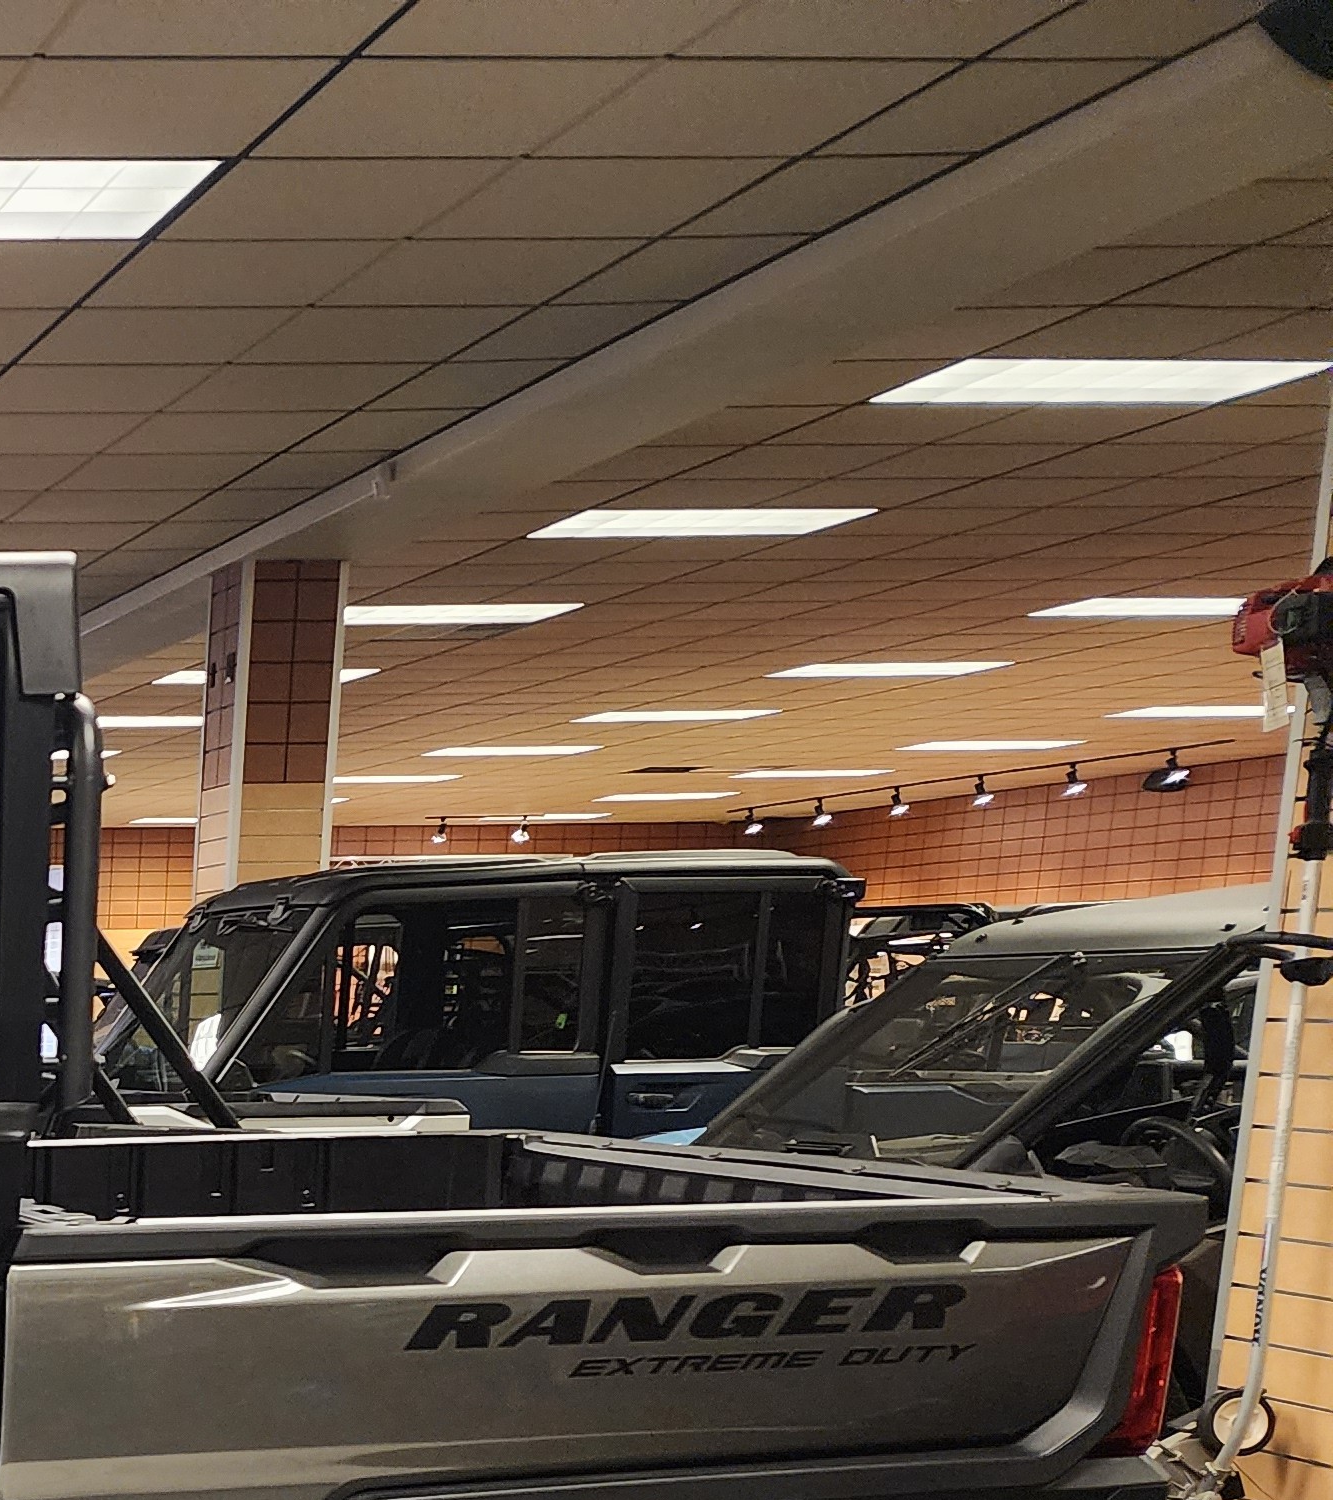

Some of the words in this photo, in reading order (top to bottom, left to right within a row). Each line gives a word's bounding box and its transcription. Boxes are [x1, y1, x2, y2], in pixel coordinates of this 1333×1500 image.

[403, 1283, 968, 1351] RANGER
[567, 1349, 823, 1379] EXTREME
[838, 1343, 977, 1368] DUTY
